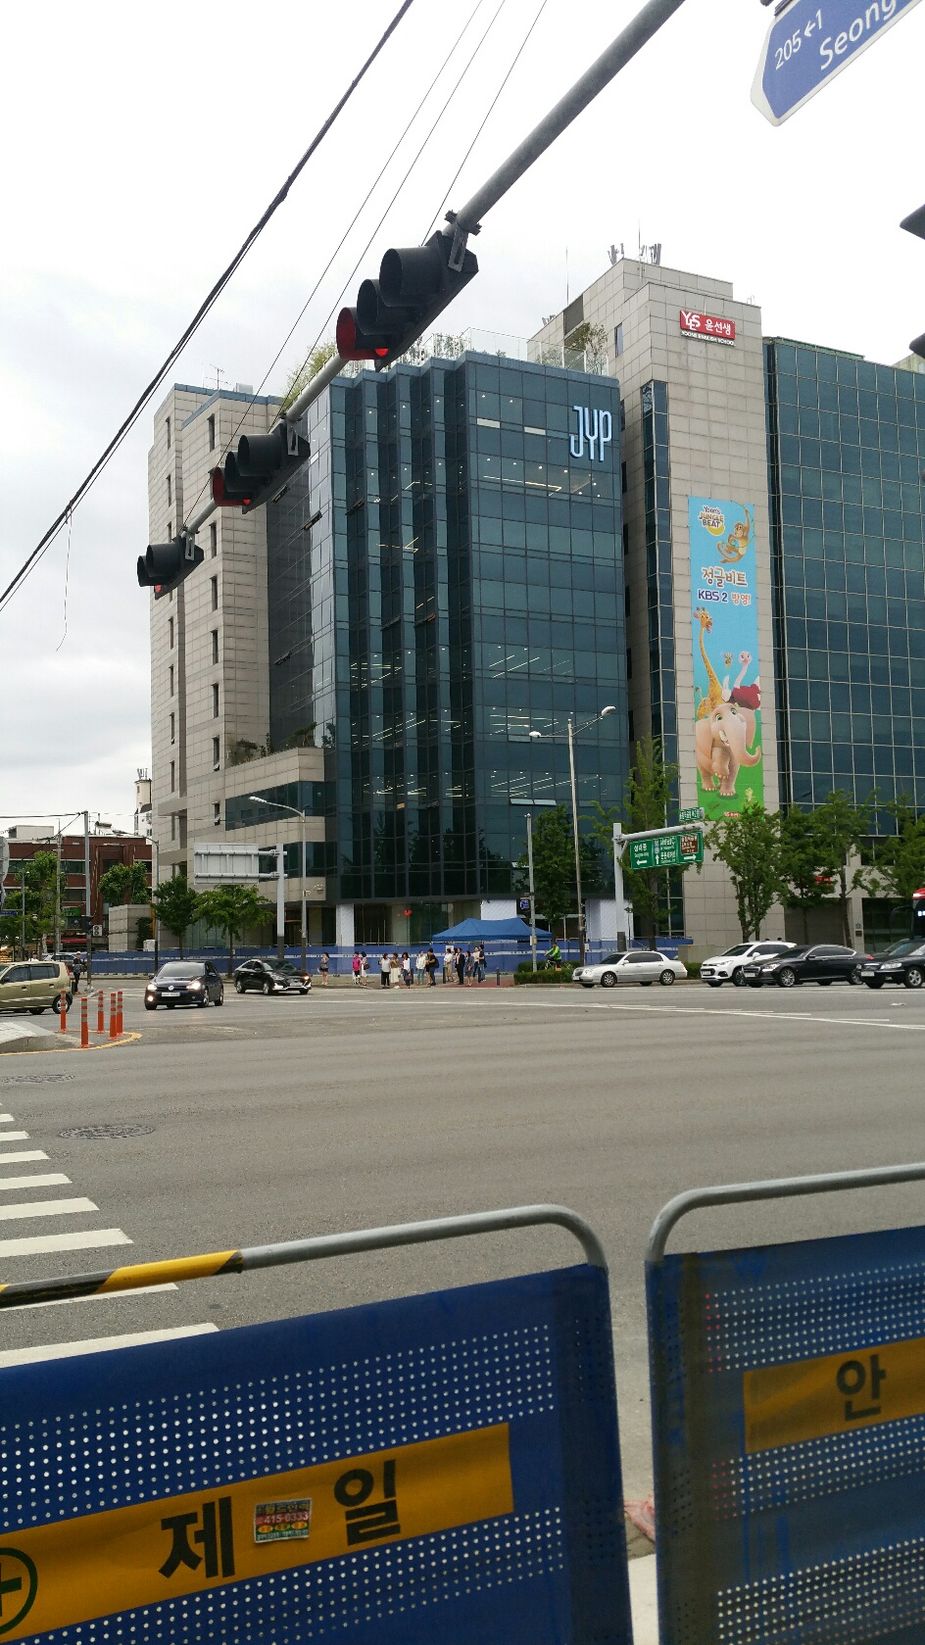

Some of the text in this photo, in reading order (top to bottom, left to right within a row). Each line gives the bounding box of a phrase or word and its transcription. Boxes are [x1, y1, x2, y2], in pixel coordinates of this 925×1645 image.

[774, 29, 802, 70] 205
[705, 318, 731, 336] 윤선생
[570, 405, 612, 462] JYP
[702, 519, 721, 528] BEAT
[702, 567, 747, 587] 정글비트
[698, 590, 720, 602] KBS
[721, 592, 728, 602] 2
[836, 1354, 886, 1422] 안
